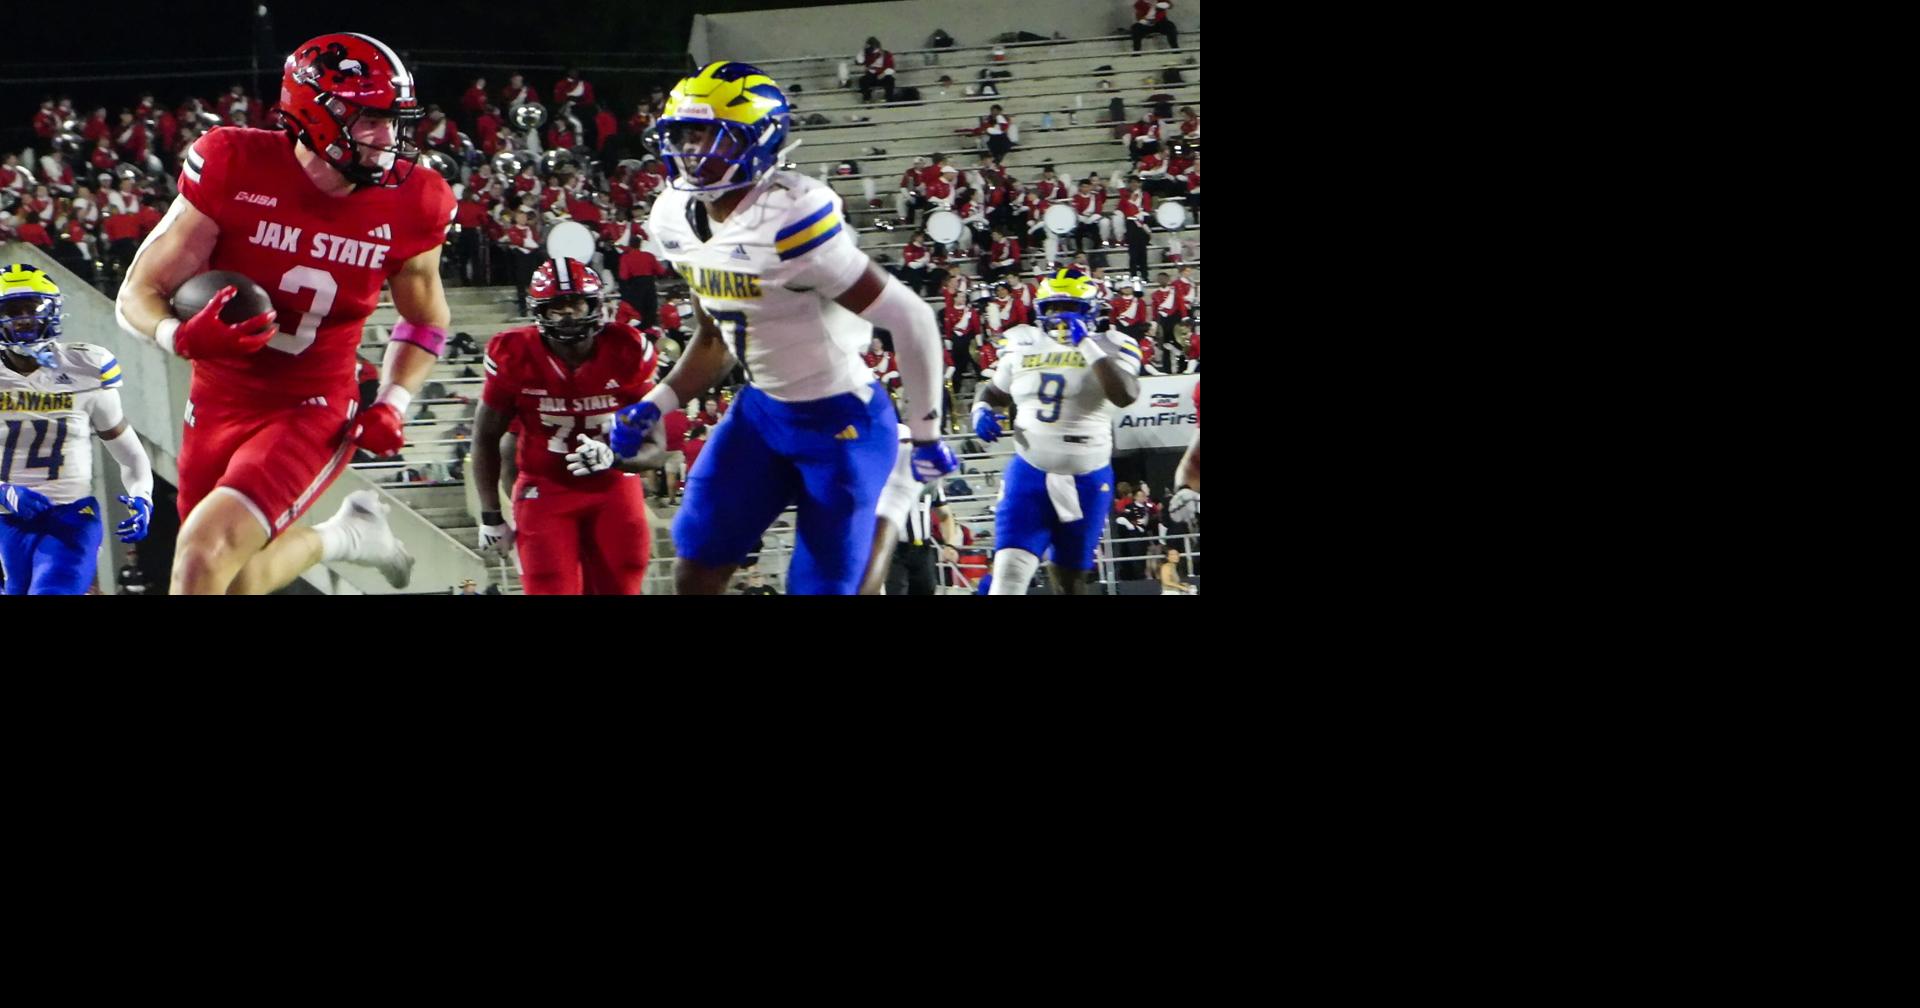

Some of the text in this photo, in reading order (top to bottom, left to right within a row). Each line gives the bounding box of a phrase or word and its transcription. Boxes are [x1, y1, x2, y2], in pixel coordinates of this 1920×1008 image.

[249, 220, 391, 269] JAX STATE
[266, 265, 338, 356] 3
[537, 393, 619, 412] JAX STATE
[1036, 372, 1067, 423] 9
[0, 417, 67, 482] 14
